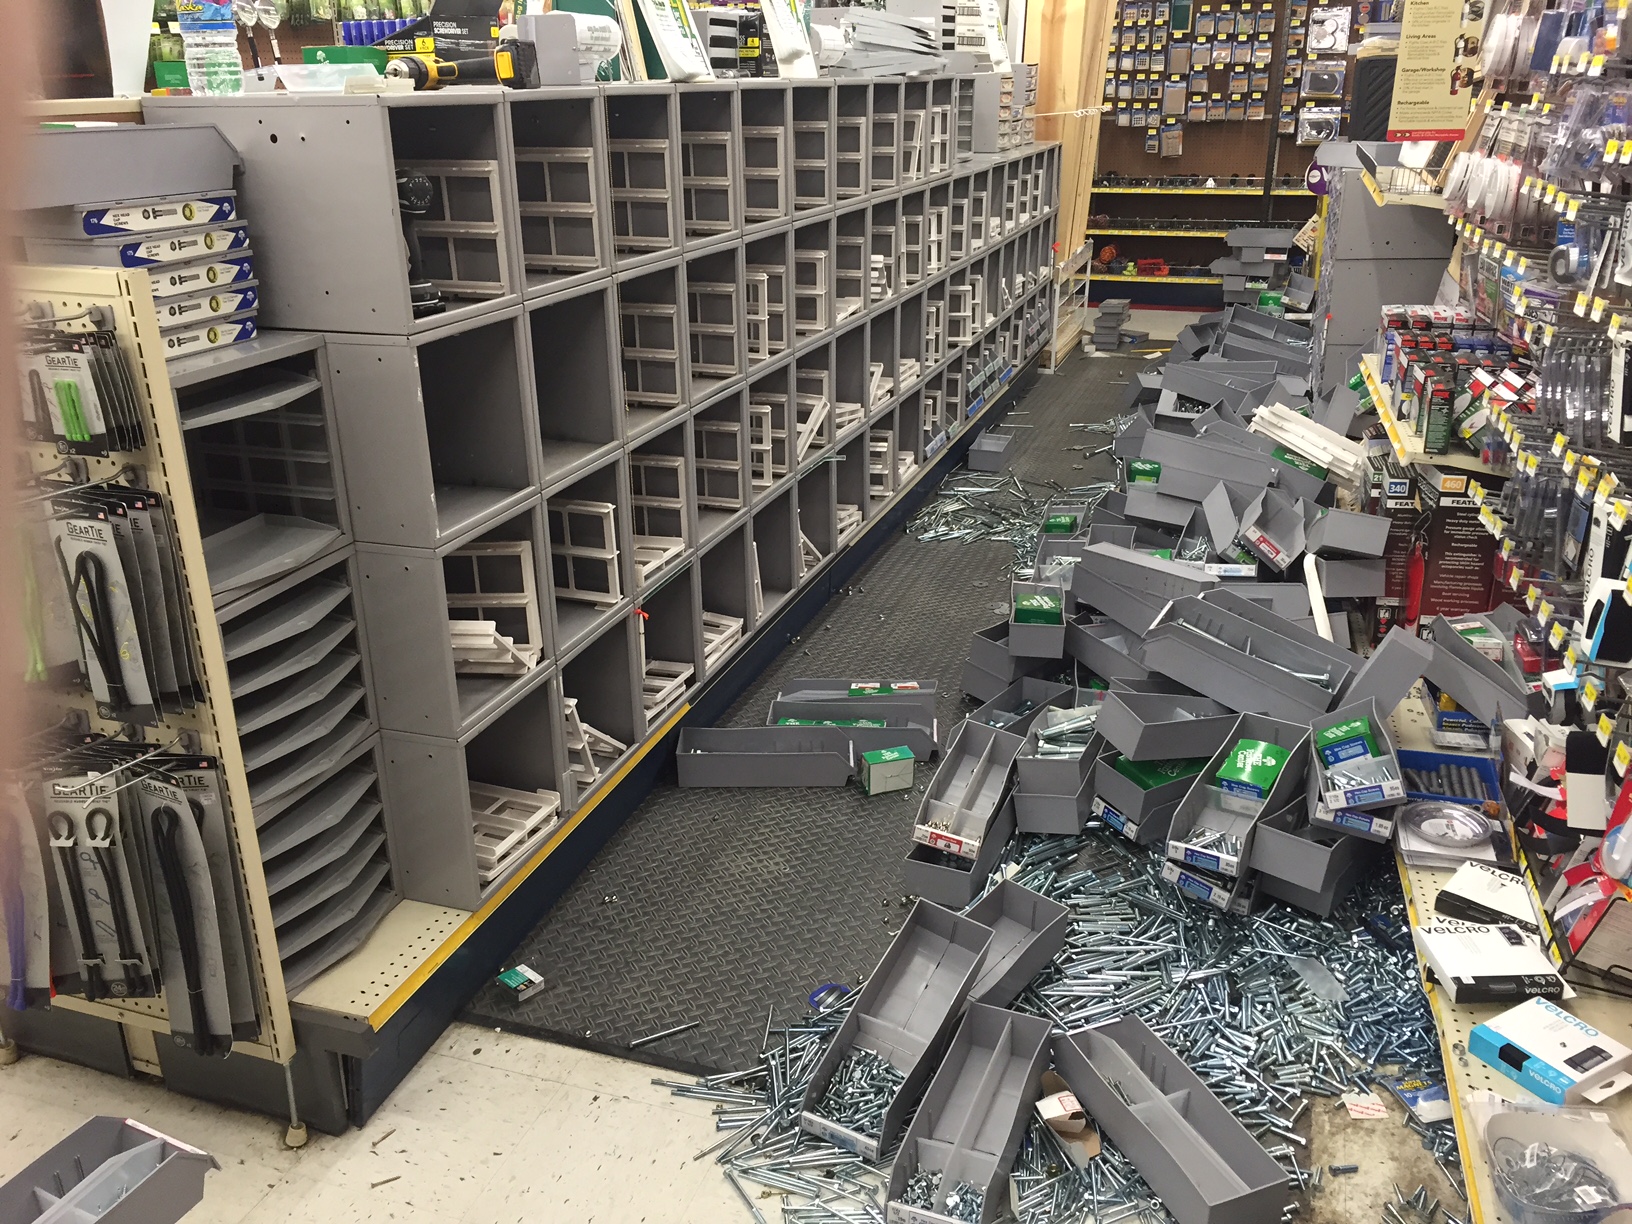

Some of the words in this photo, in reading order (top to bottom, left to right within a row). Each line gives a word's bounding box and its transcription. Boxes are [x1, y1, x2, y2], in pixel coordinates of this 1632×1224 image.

[1389, 484, 1406, 493] 340
[1445, 481, 1462, 489] 460
[66, 521, 105, 539] GEARTIE
[179, 774, 206, 786] RTIE
[141, 779, 178, 799] GEARTIE
[1420, 925, 1491, 934] VELCRO
[1524, 986, 1560, 994] VELCRO
[1535, 997, 1599, 1038] VELCRO
[1528, 1069, 1562, 1094] VELCRO
